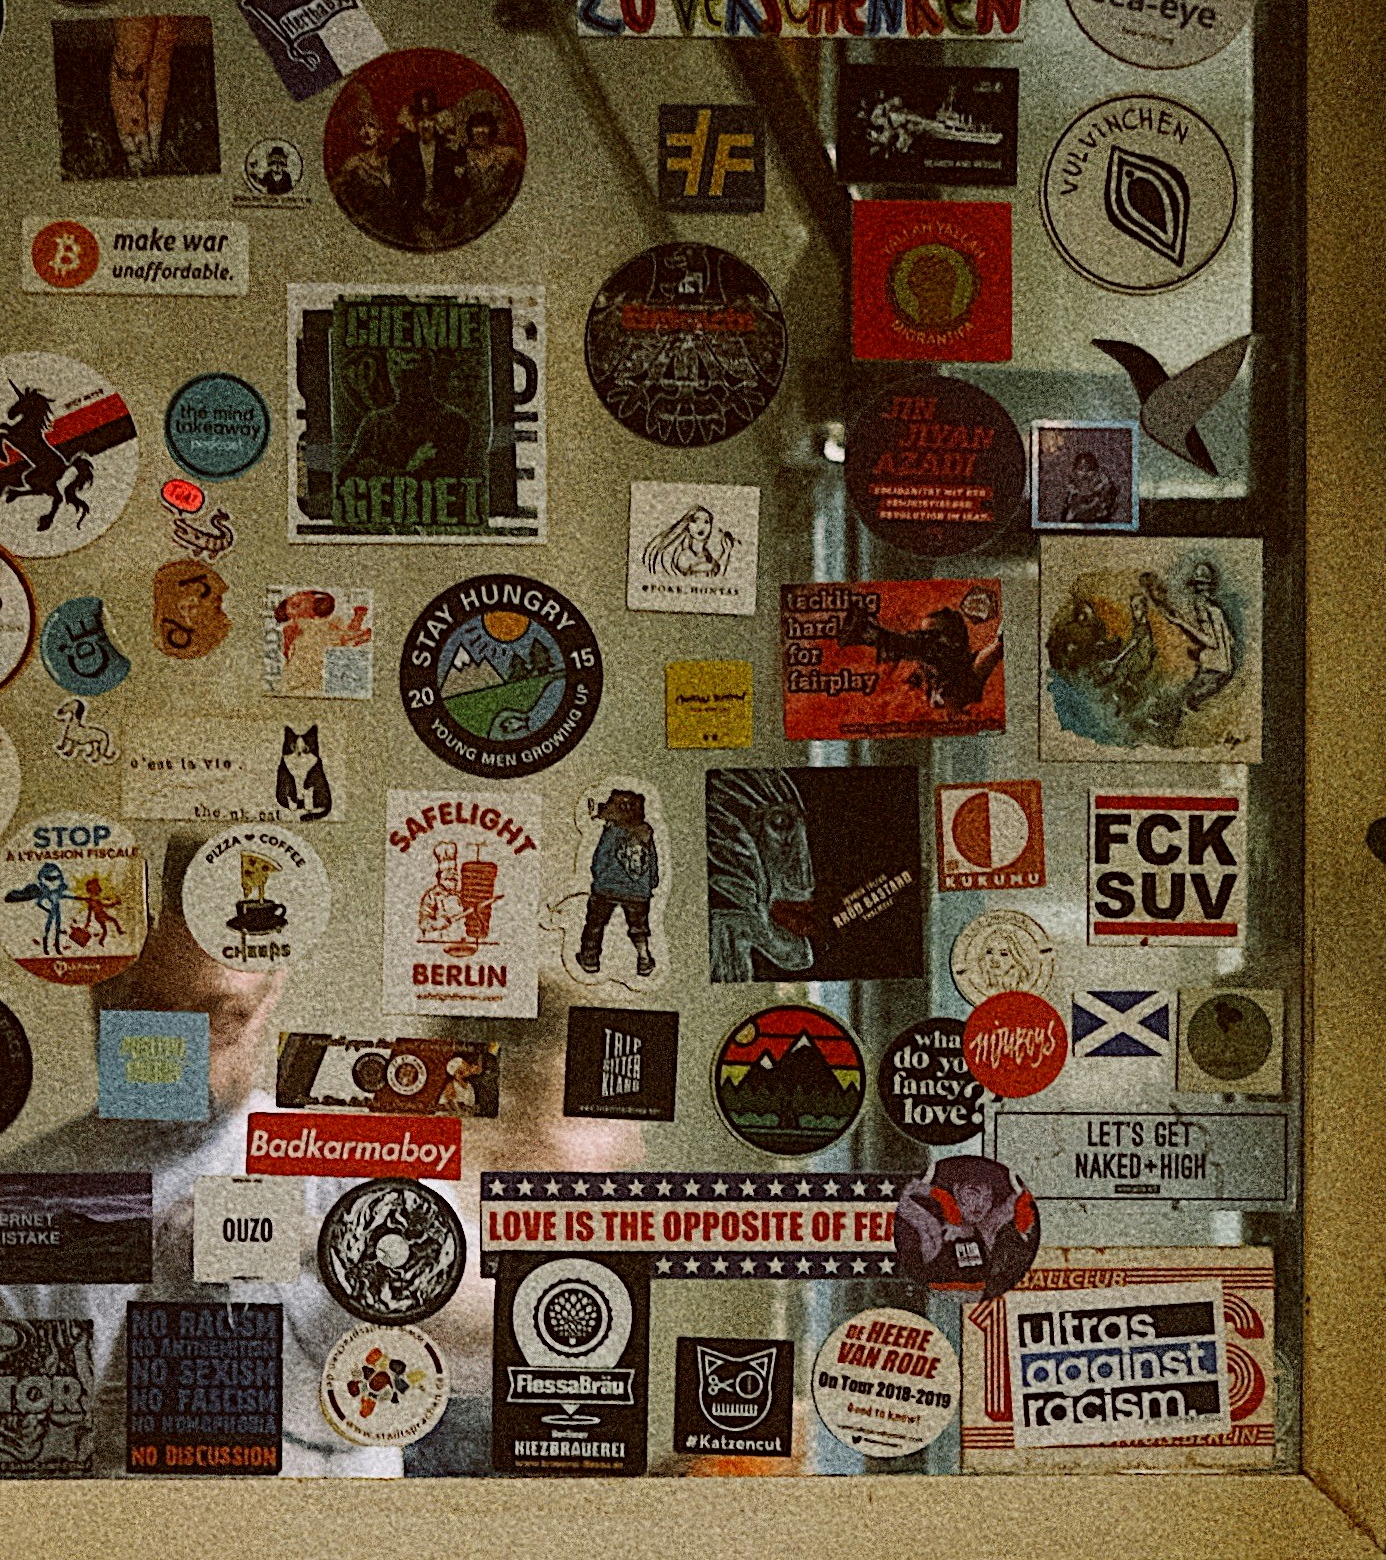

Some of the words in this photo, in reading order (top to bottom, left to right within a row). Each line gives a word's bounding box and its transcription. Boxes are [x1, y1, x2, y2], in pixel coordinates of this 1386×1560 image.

[113, 229, 178, 251] make
[184, 233, 228, 251] war
[112, 260, 234, 283] unaffordable.
[181, 406, 207, 419] the
[213, 407, 254, 421] mind
[176, 420, 261, 438] takeaway
[412, 603, 457, 668] STAY
[459, 583, 576, 633] HUNGRY
[787, 617, 840, 638] hard
[570, 648, 595, 669] 15
[787, 644, 822, 665] for
[788, 671, 878, 695] fairplay
[408, 687, 435, 708] 20
[429, 719, 476, 763] YOUNG
[481, 751, 518, 768] MEN
[521, 708, 583, 765] GROWING
[574, 683, 590, 706] UP
[33, 825, 110, 848] STOP
[390, 803, 537, 858] SAFELIGHT
[1095, 815, 1237, 866] FCK
[206, 836, 240, 864] PIZZA
[259, 833, 305, 868] COFFEE
[1095, 873, 1237, 919] SUV
[222, 943, 291, 962] CHEERS
[413, 964, 507, 987] BERLIN
[604, 1028, 642, 1055] TRIP
[894, 1047, 929, 1069] do
[892, 1073, 965, 1098] fancy
[250, 1124, 456, 1169] Badkarmaboy
[1087, 1121, 1144, 1147] LET'S
[1154, 1122, 1190, 1147] GET
[222, 1217, 273, 1242] OUZO
[489, 1212, 557, 1241] LOVE
[565, 1212, 594, 1241] IS
[603, 1212, 654, 1241] THE
[664, 1212, 803, 1241] OPPOSITE
[813, 1212, 847, 1241] OF
[131, 1310, 167, 1336] NO
[178, 1310, 277, 1337] RACISM
[1021, 1312, 1155, 1347] ultras
[868, 1321, 935, 1352] HEERE
[131, 1360, 167, 1386] NO
[178, 1360, 277, 1386] SEXISM
[837, 1341, 881, 1369] VAN
[884, 1349, 941, 1380] RODE
[1023, 1343, 1209, 1392] against
[516, 1374, 625, 1395] FlessaBräu
[819, 1371, 839, 1390] On
[841, 1376, 874, 1397] Tour
[131, 1390, 162, 1413] NO
[1025, 1387, 1197, 1424] racism.
[514, 1441, 626, 1459] KIEZBRAUEREI
[685, 1434, 782, 1452] #Katzencut
[131, 1446, 158, 1466] NO
[166, 1446, 277, 1467] DISCUSSION
